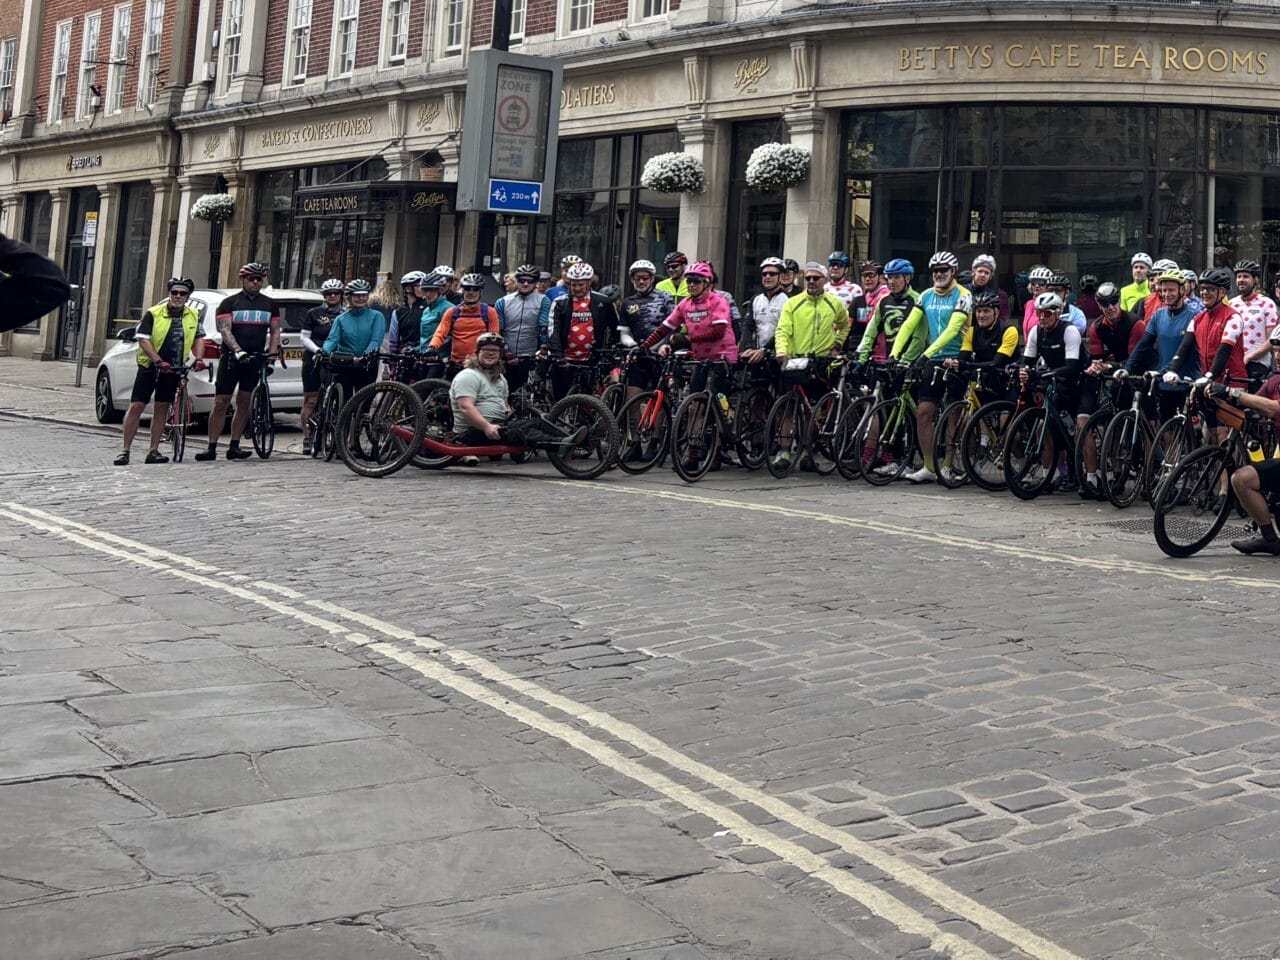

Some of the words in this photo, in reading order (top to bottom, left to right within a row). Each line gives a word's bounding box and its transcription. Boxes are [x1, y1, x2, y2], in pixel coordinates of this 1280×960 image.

[899, 44, 993, 71] BETTYS
[1004, 43, 1081, 69] CAFE
[1094, 44, 1151, 70] TEA
[1163, 46, 1269, 75] ROOMS
[500, 79, 532, 93] ZONE
[261, 127, 291, 148] BAKERS
[301, 115, 374, 143] CONFECTIONERS
[411, 191, 449, 211] Bettys
[511, 191, 530, 200] 230m
[304, 198, 320, 212] CAFE
